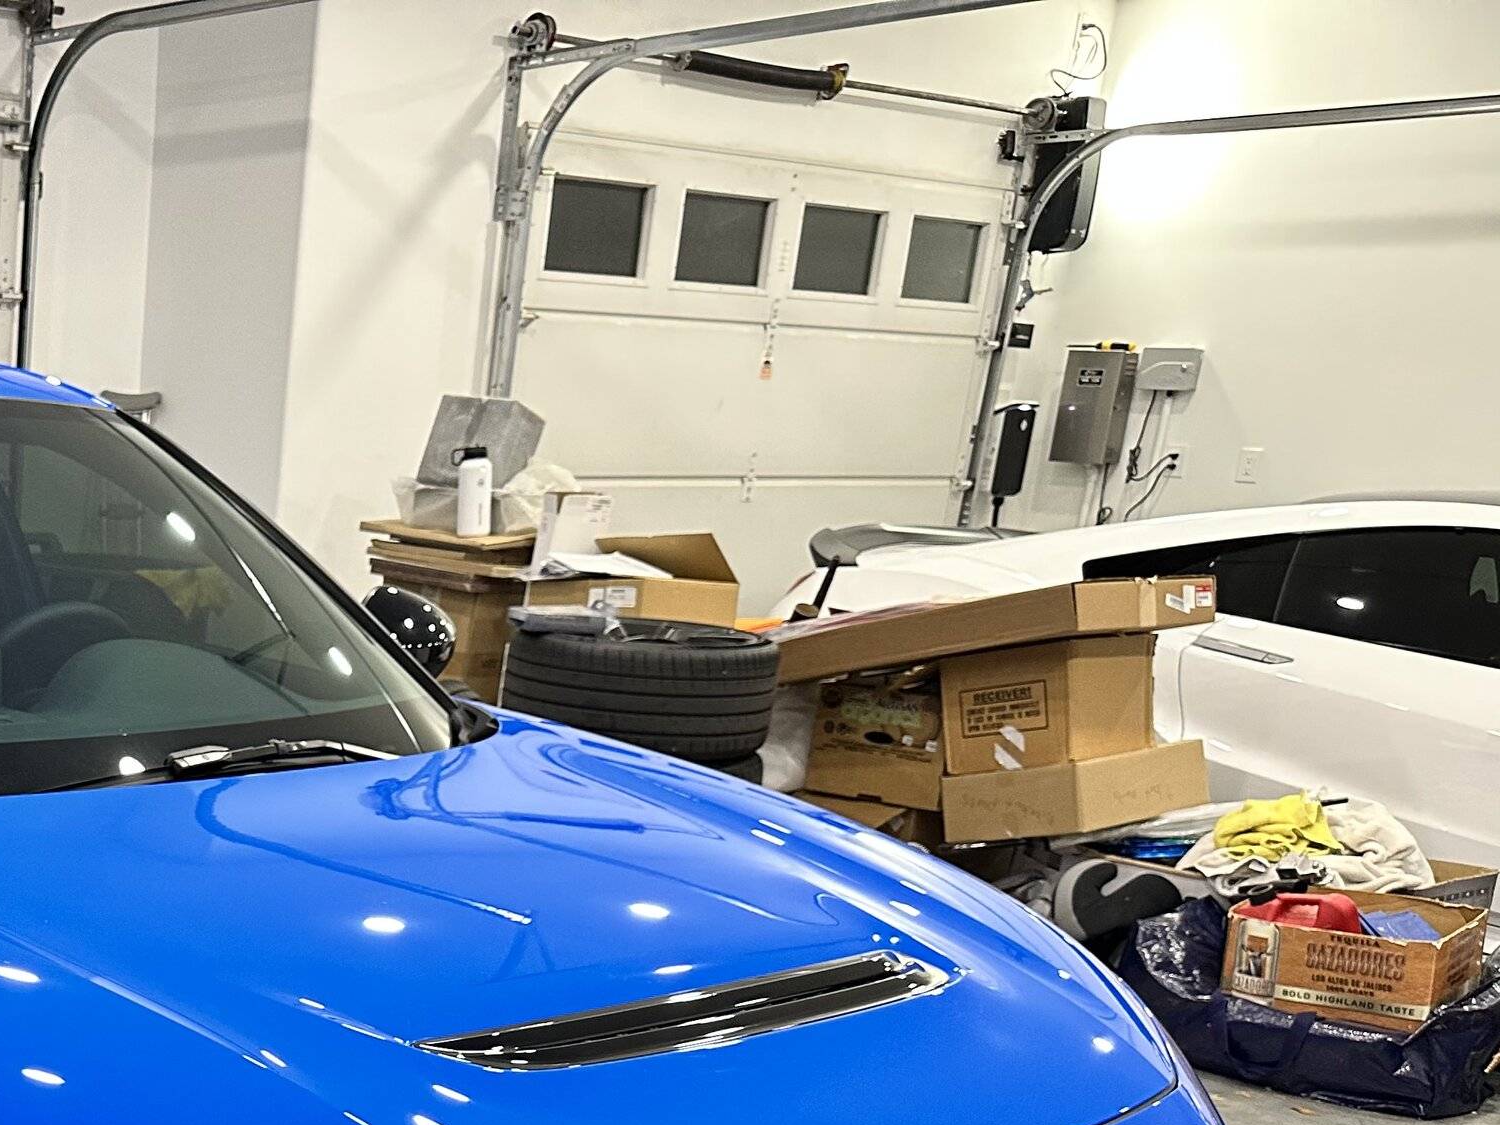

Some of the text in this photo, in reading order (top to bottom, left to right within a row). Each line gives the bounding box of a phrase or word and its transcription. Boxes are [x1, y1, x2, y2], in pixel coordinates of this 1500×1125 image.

[1330, 934, 1381, 948] TEQUILA
[1282, 989, 1416, 1017] BOLD HIGHLAND TASTE
